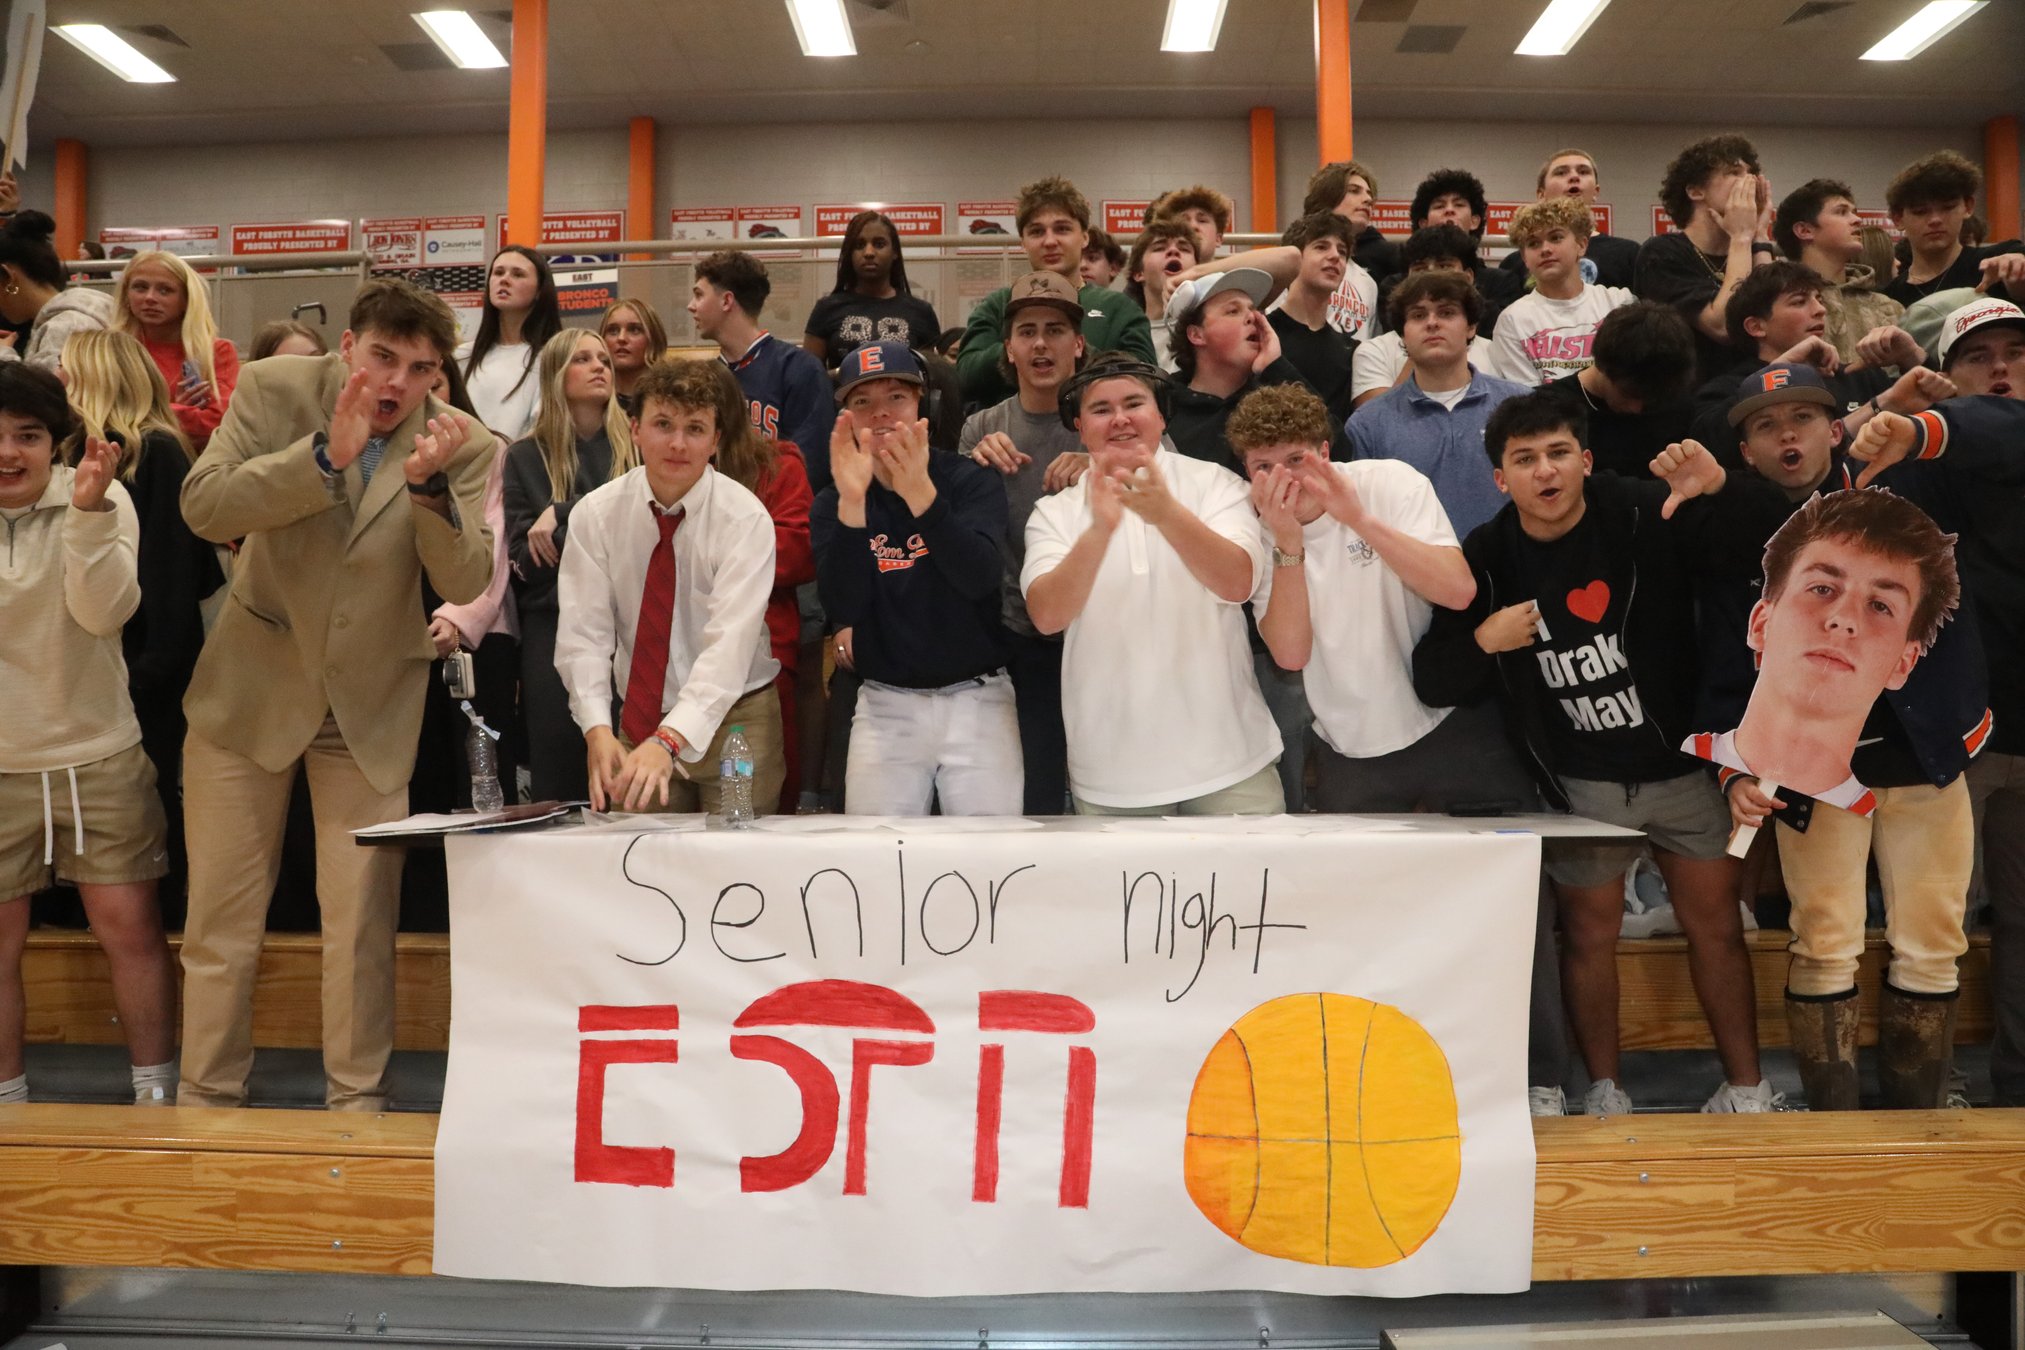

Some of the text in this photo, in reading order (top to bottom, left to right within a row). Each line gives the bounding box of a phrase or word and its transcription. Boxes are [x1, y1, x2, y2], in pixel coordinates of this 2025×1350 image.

[820, 212, 842, 220] EAST
[1109, 208, 1131, 217] EAST
[566, 218, 617, 228] VOLLEYBALL
[918, 222, 930, 230] BY
[236, 228, 346, 240] EAST FORSYTH BASKETBALL
[550, 230, 596, 240] PRESENTED
[598, 230, 610, 238] BY
[244, 240, 338, 250] PROUDLY PRESENTED BY
[572, 273, 592, 282] EAST
[557, 288, 608, 301] BRONCO
[558, 298, 614, 310] TUDENTS
[1956, 304, 2020, 334] Georgia
[859, 346, 885, 375] E
[1761, 368, 1791, 392] E
[1559, 684, 1644, 732] May
[1123, 868, 1306, 1002] night
